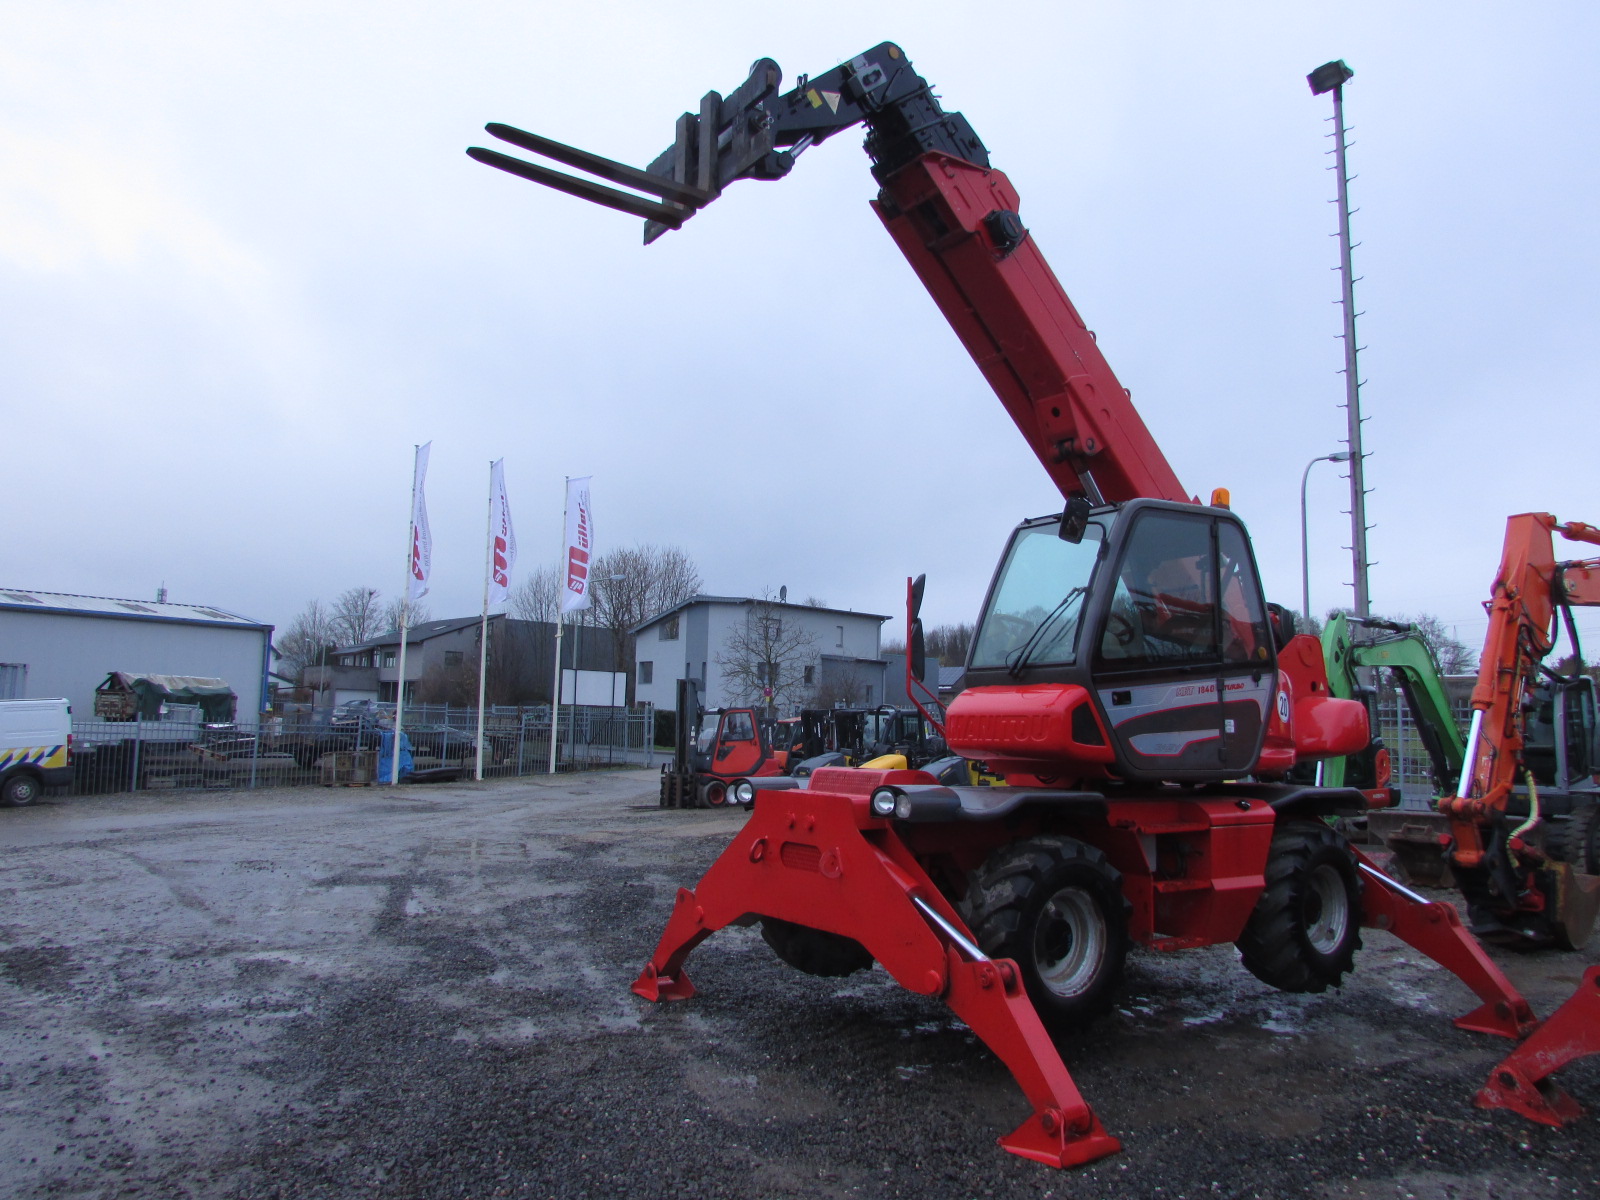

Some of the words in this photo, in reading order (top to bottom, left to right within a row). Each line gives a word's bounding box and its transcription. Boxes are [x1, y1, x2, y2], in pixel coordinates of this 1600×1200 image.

[1198, 685, 1215, 694] 1840
[1279, 696, 1288, 717] 20
[948, 714, 1051, 742] MANITOU
